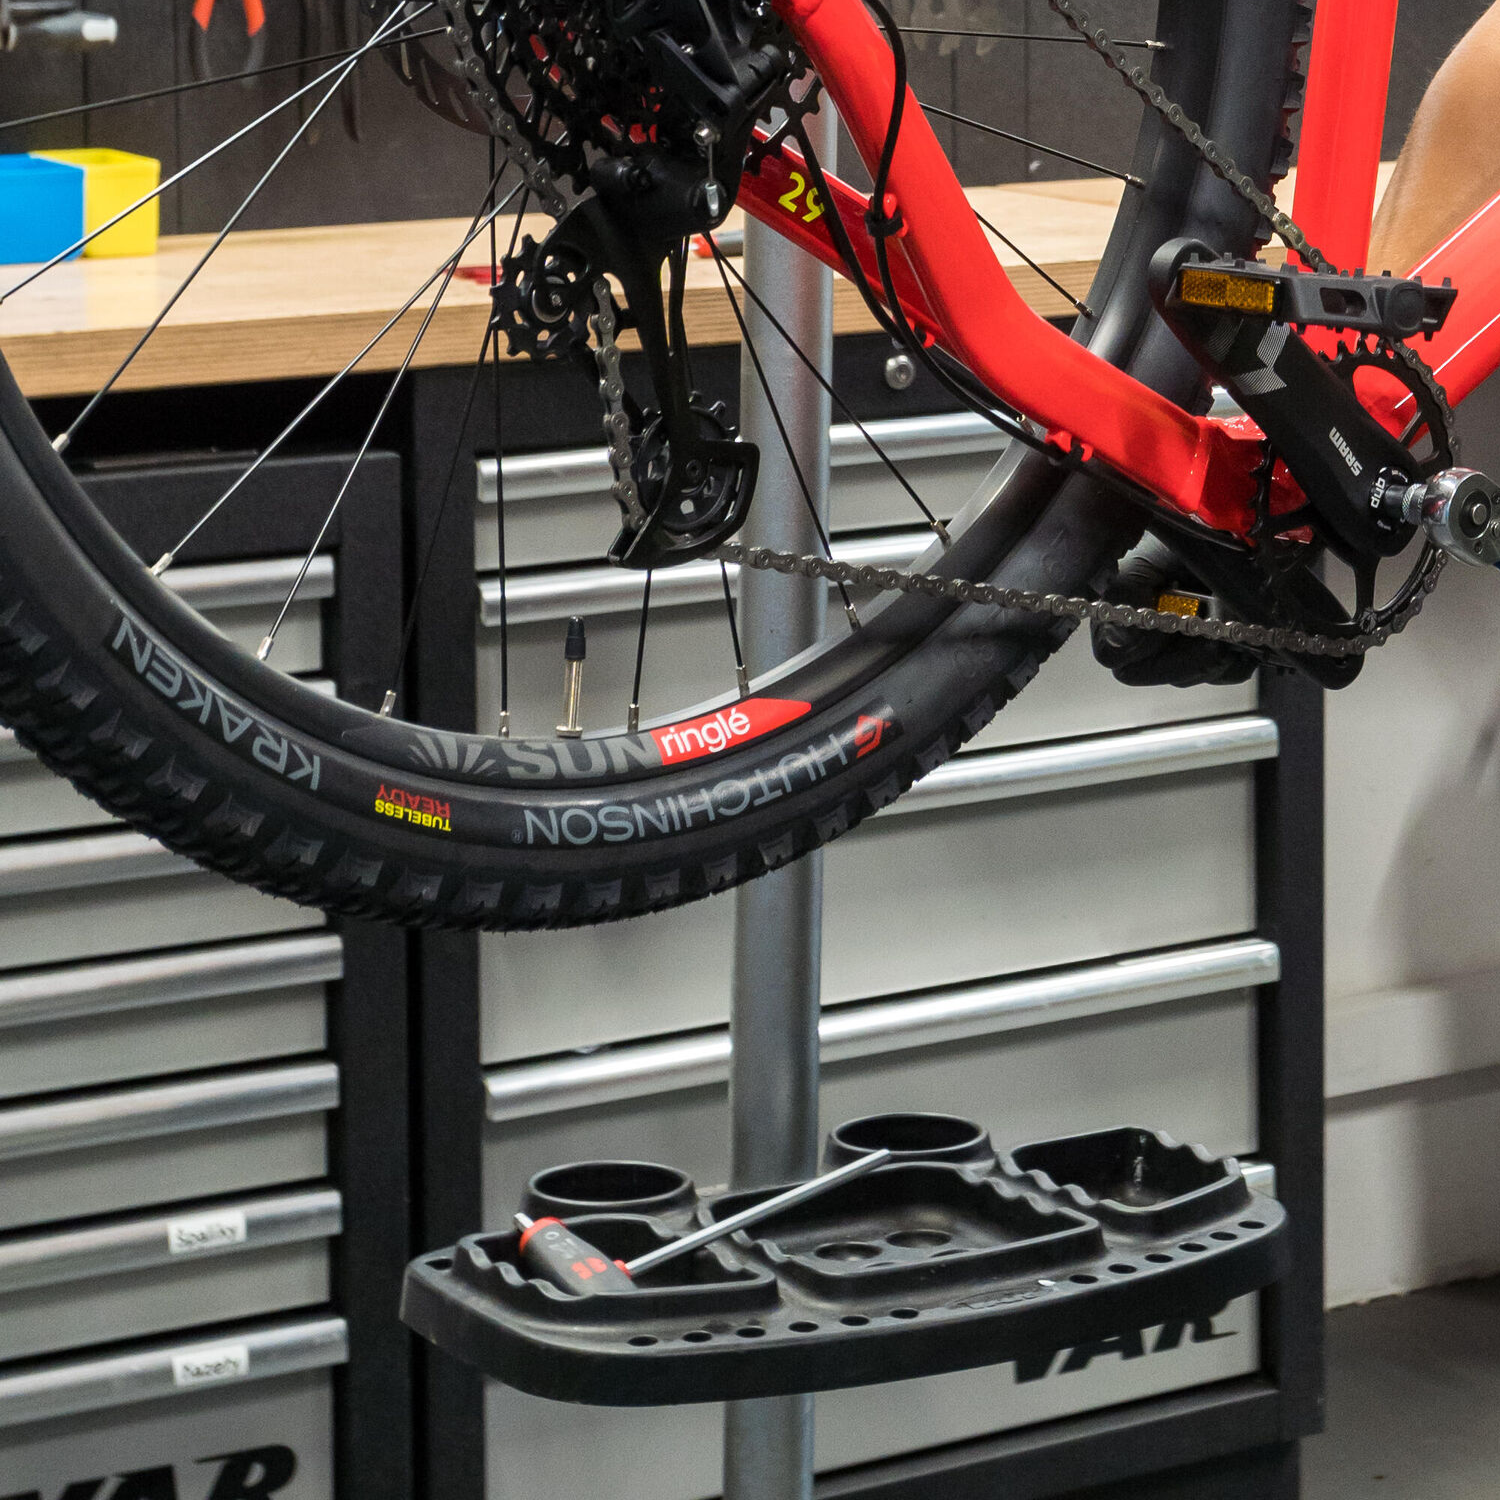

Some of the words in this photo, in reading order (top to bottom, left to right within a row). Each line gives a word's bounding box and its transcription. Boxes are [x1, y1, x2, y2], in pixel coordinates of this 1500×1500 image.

[1328, 426, 1363, 477] SRAM
[1371, 477, 1386, 508] dub
[112, 616, 321, 791] KRAKEN
[505, 732, 664, 781] SUN
[660, 707, 752, 759] ringlé
[376, 783, 451, 819] READY
[525, 732, 849, 846] HUTCHINSON
[374, 799, 452, 832] TUBELESS
